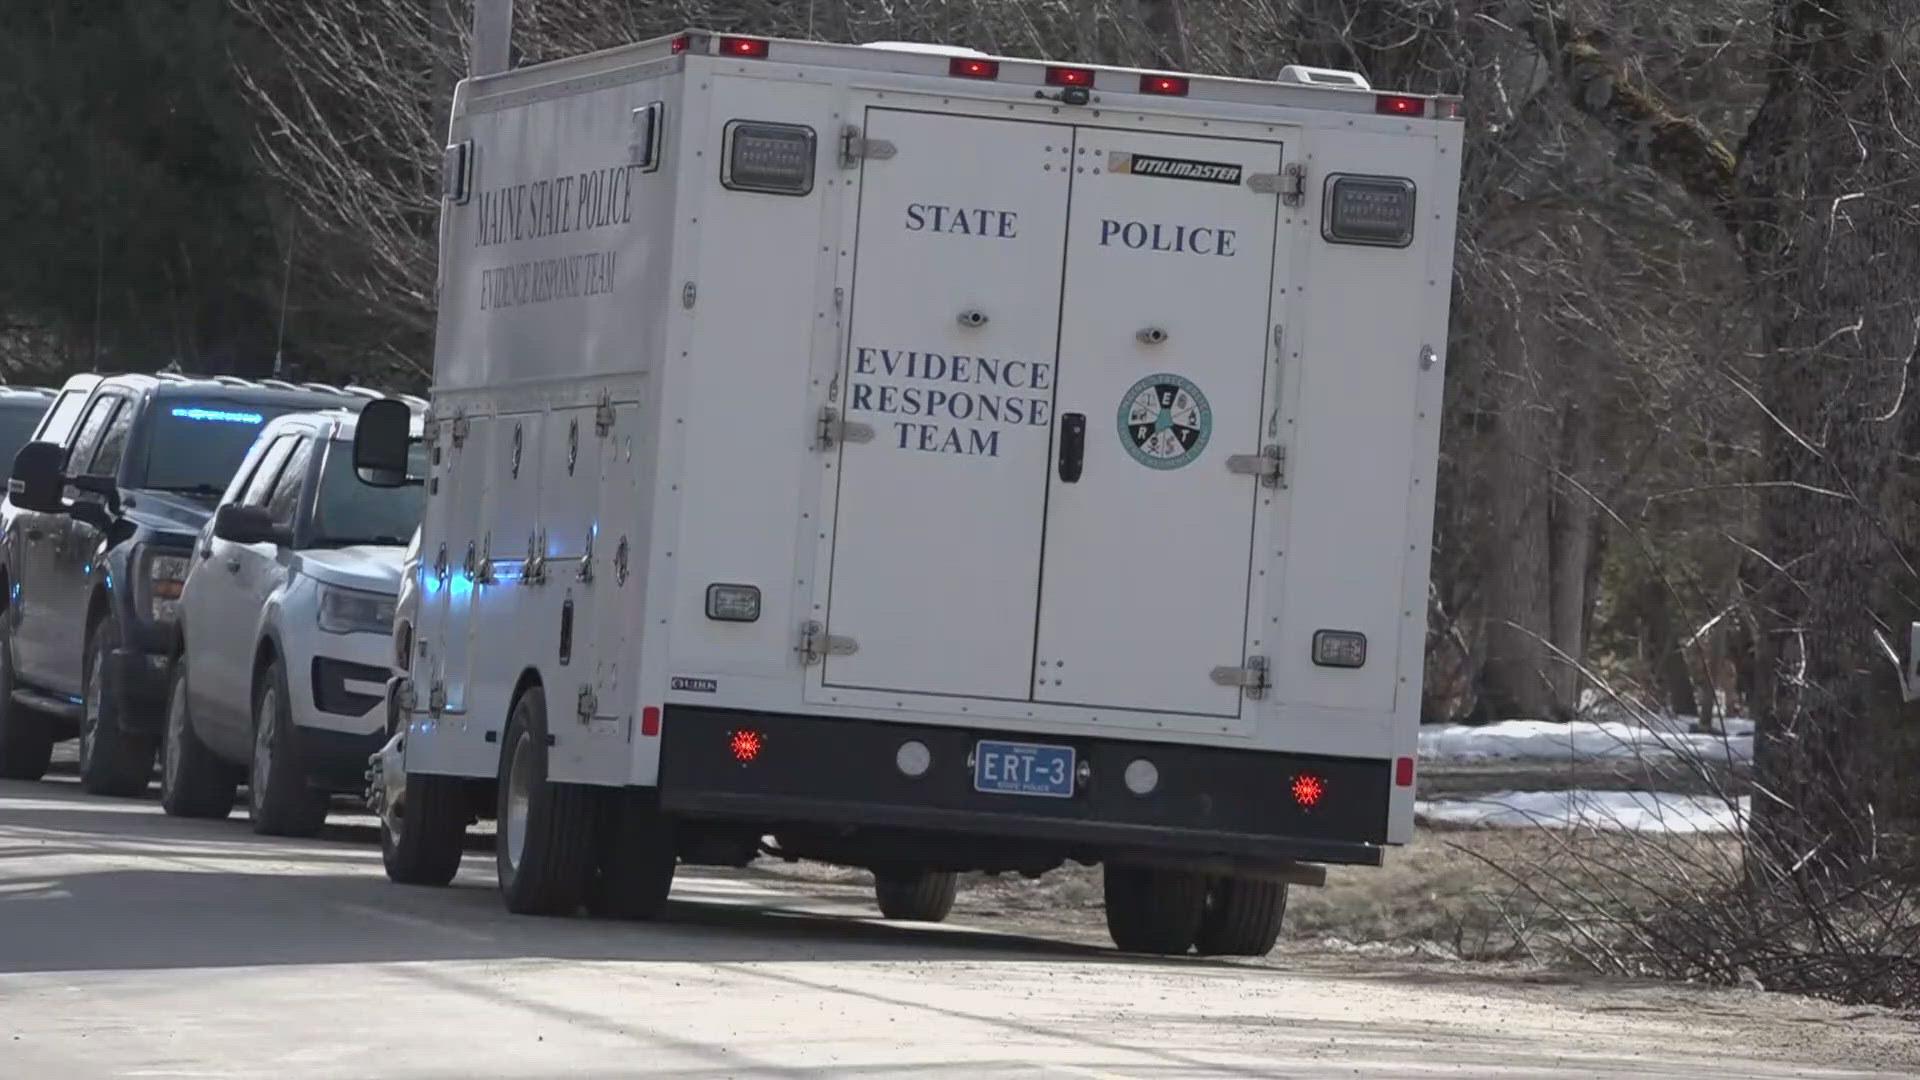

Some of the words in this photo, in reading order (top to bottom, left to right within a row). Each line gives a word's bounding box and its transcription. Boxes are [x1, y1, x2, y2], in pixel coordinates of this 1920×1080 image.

[475, 184, 527, 247] MAINE
[528, 175, 574, 239] STATE
[575, 166, 635, 231] POLICE
[905, 203, 1018, 239] STATE
[1099, 219, 1237, 257] POLICE
[481, 262, 530, 310] EVIDENCE
[583, 251, 616, 297] TEAM
[854, 347, 1049, 391] EVIDENCE
[851, 383, 1049, 427] RESPONSE
[894, 421, 1000, 457] TEAM
[984, 752, 1066, 785] ERT-3
